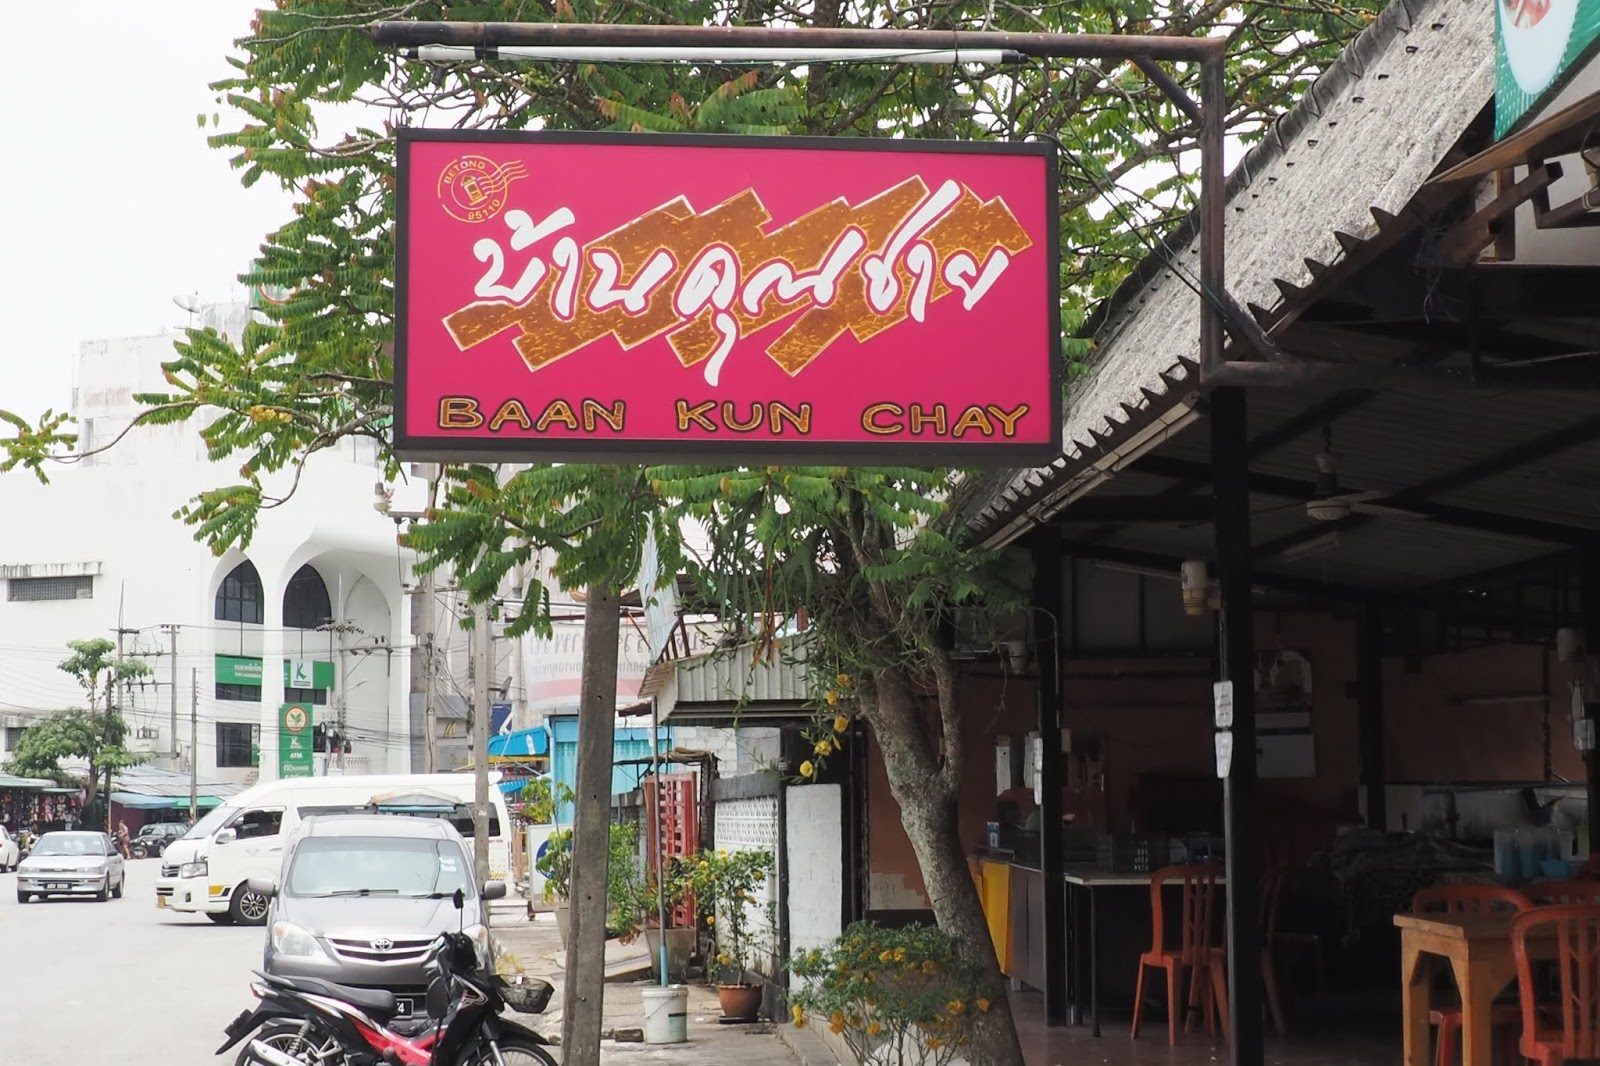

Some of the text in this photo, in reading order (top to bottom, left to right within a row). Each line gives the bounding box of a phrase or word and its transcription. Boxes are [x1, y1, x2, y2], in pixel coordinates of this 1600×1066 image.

[443, 159, 485, 184] BETONG
[467, 198, 501, 220] 95110
[473, 179, 1009, 387] บ้านคุณชาย
[438, 396, 1030, 438] BAAN KUN CHAY
